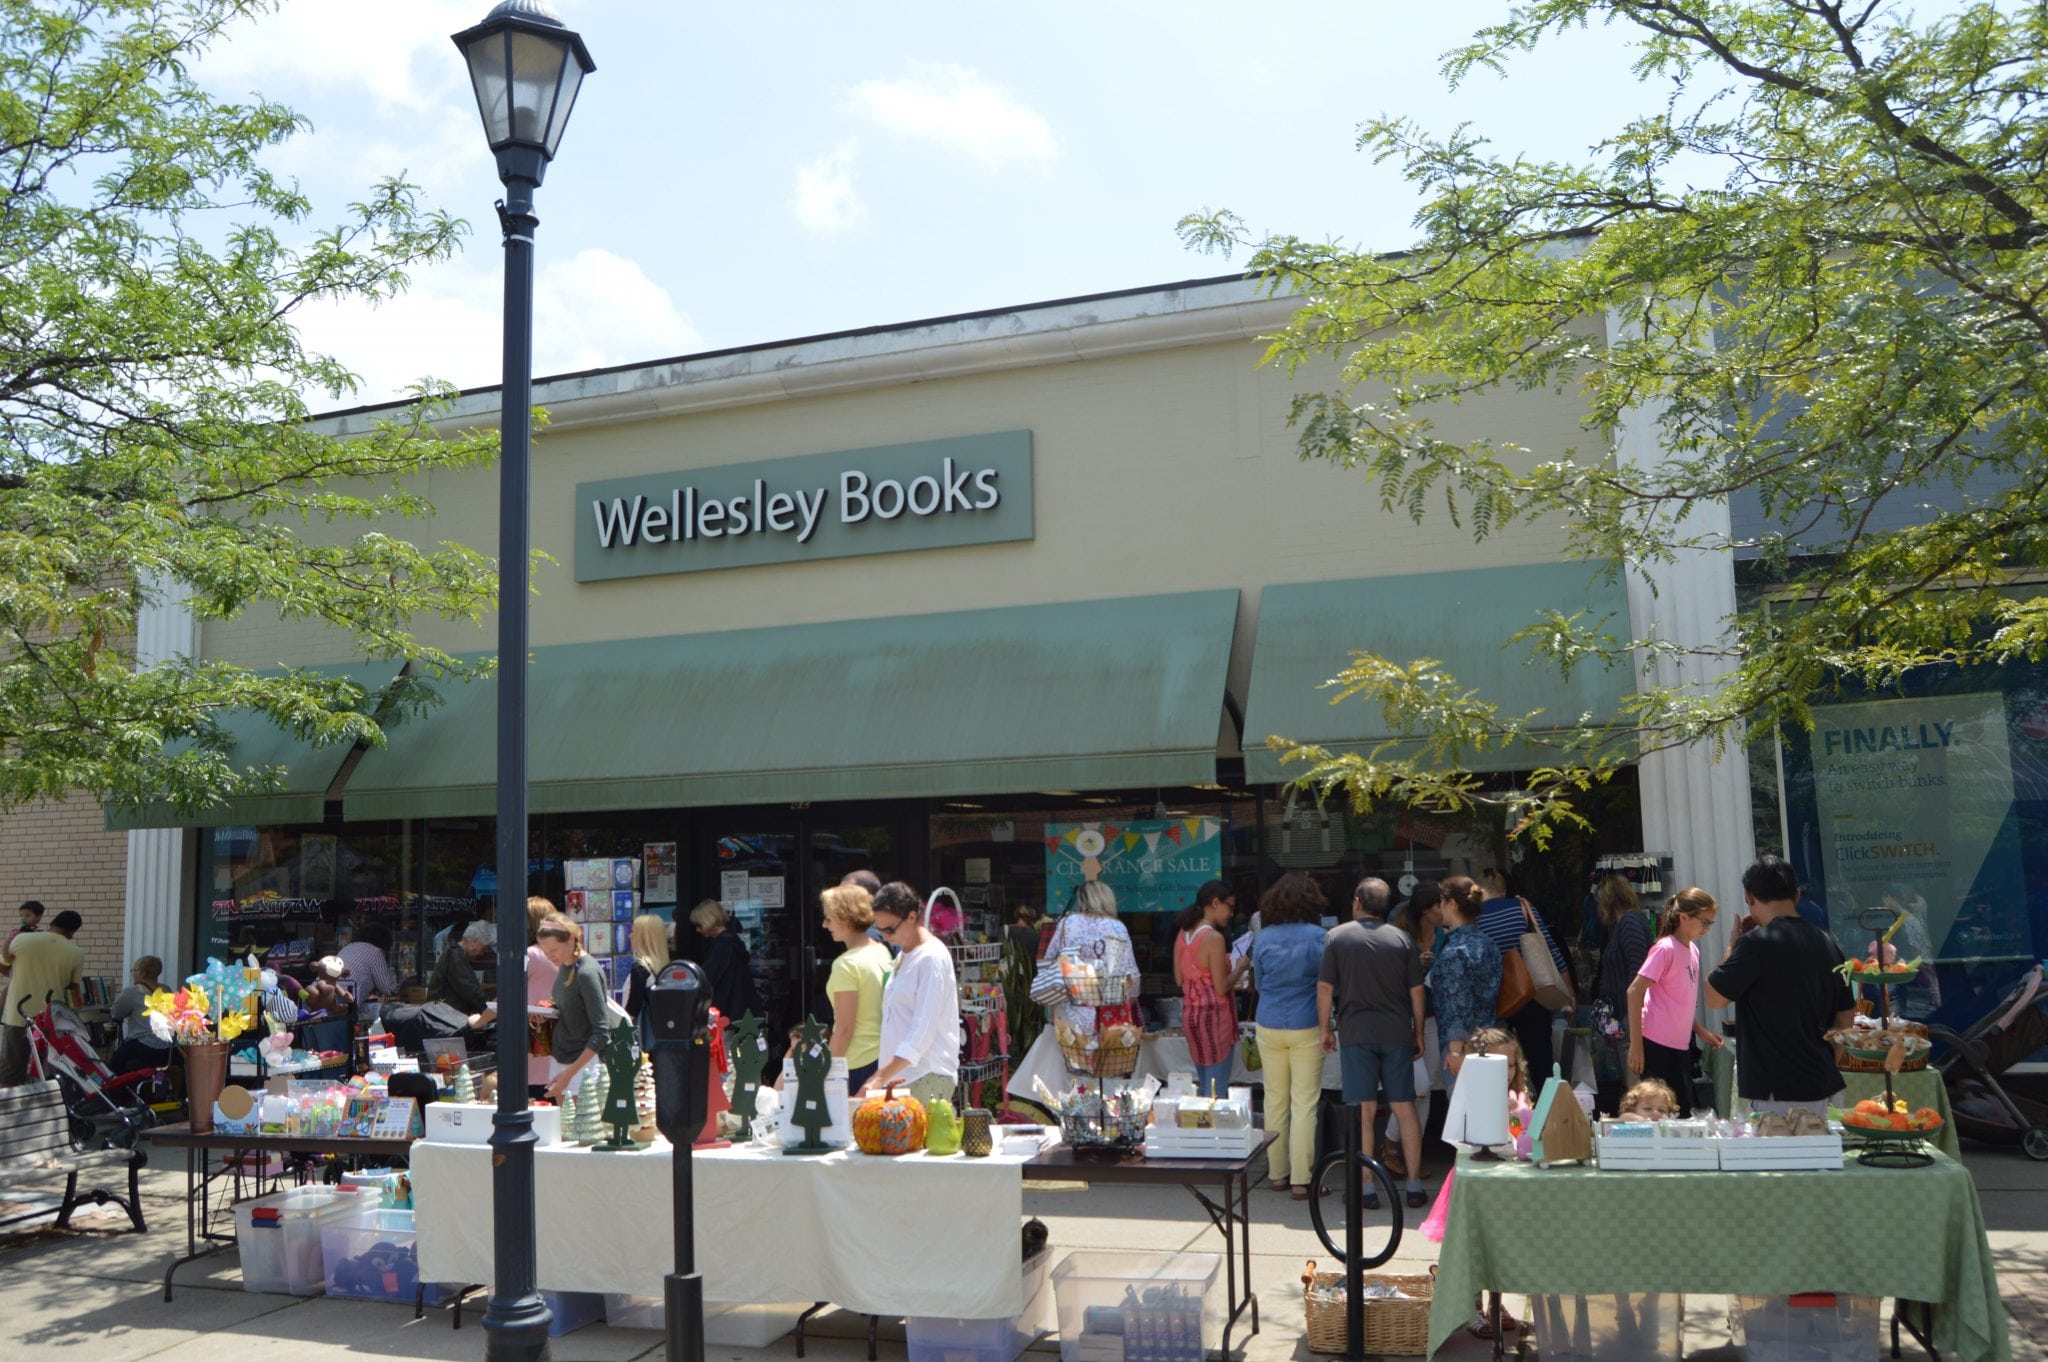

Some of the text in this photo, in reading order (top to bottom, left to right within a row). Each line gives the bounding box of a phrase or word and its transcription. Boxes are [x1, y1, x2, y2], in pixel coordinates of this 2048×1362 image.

[593, 457, 999, 548] Wellesley Books
[1824, 721, 1961, 755] FINALLY.
[1887, 760, 1919, 772] way
[1828, 773, 1948, 793] to switch banks.
[1833, 830, 1903, 842] Introducing
[1835, 842, 1941, 861] ClickSWITCH.
[1056, 857, 1210, 876] CLRANCE SALE
